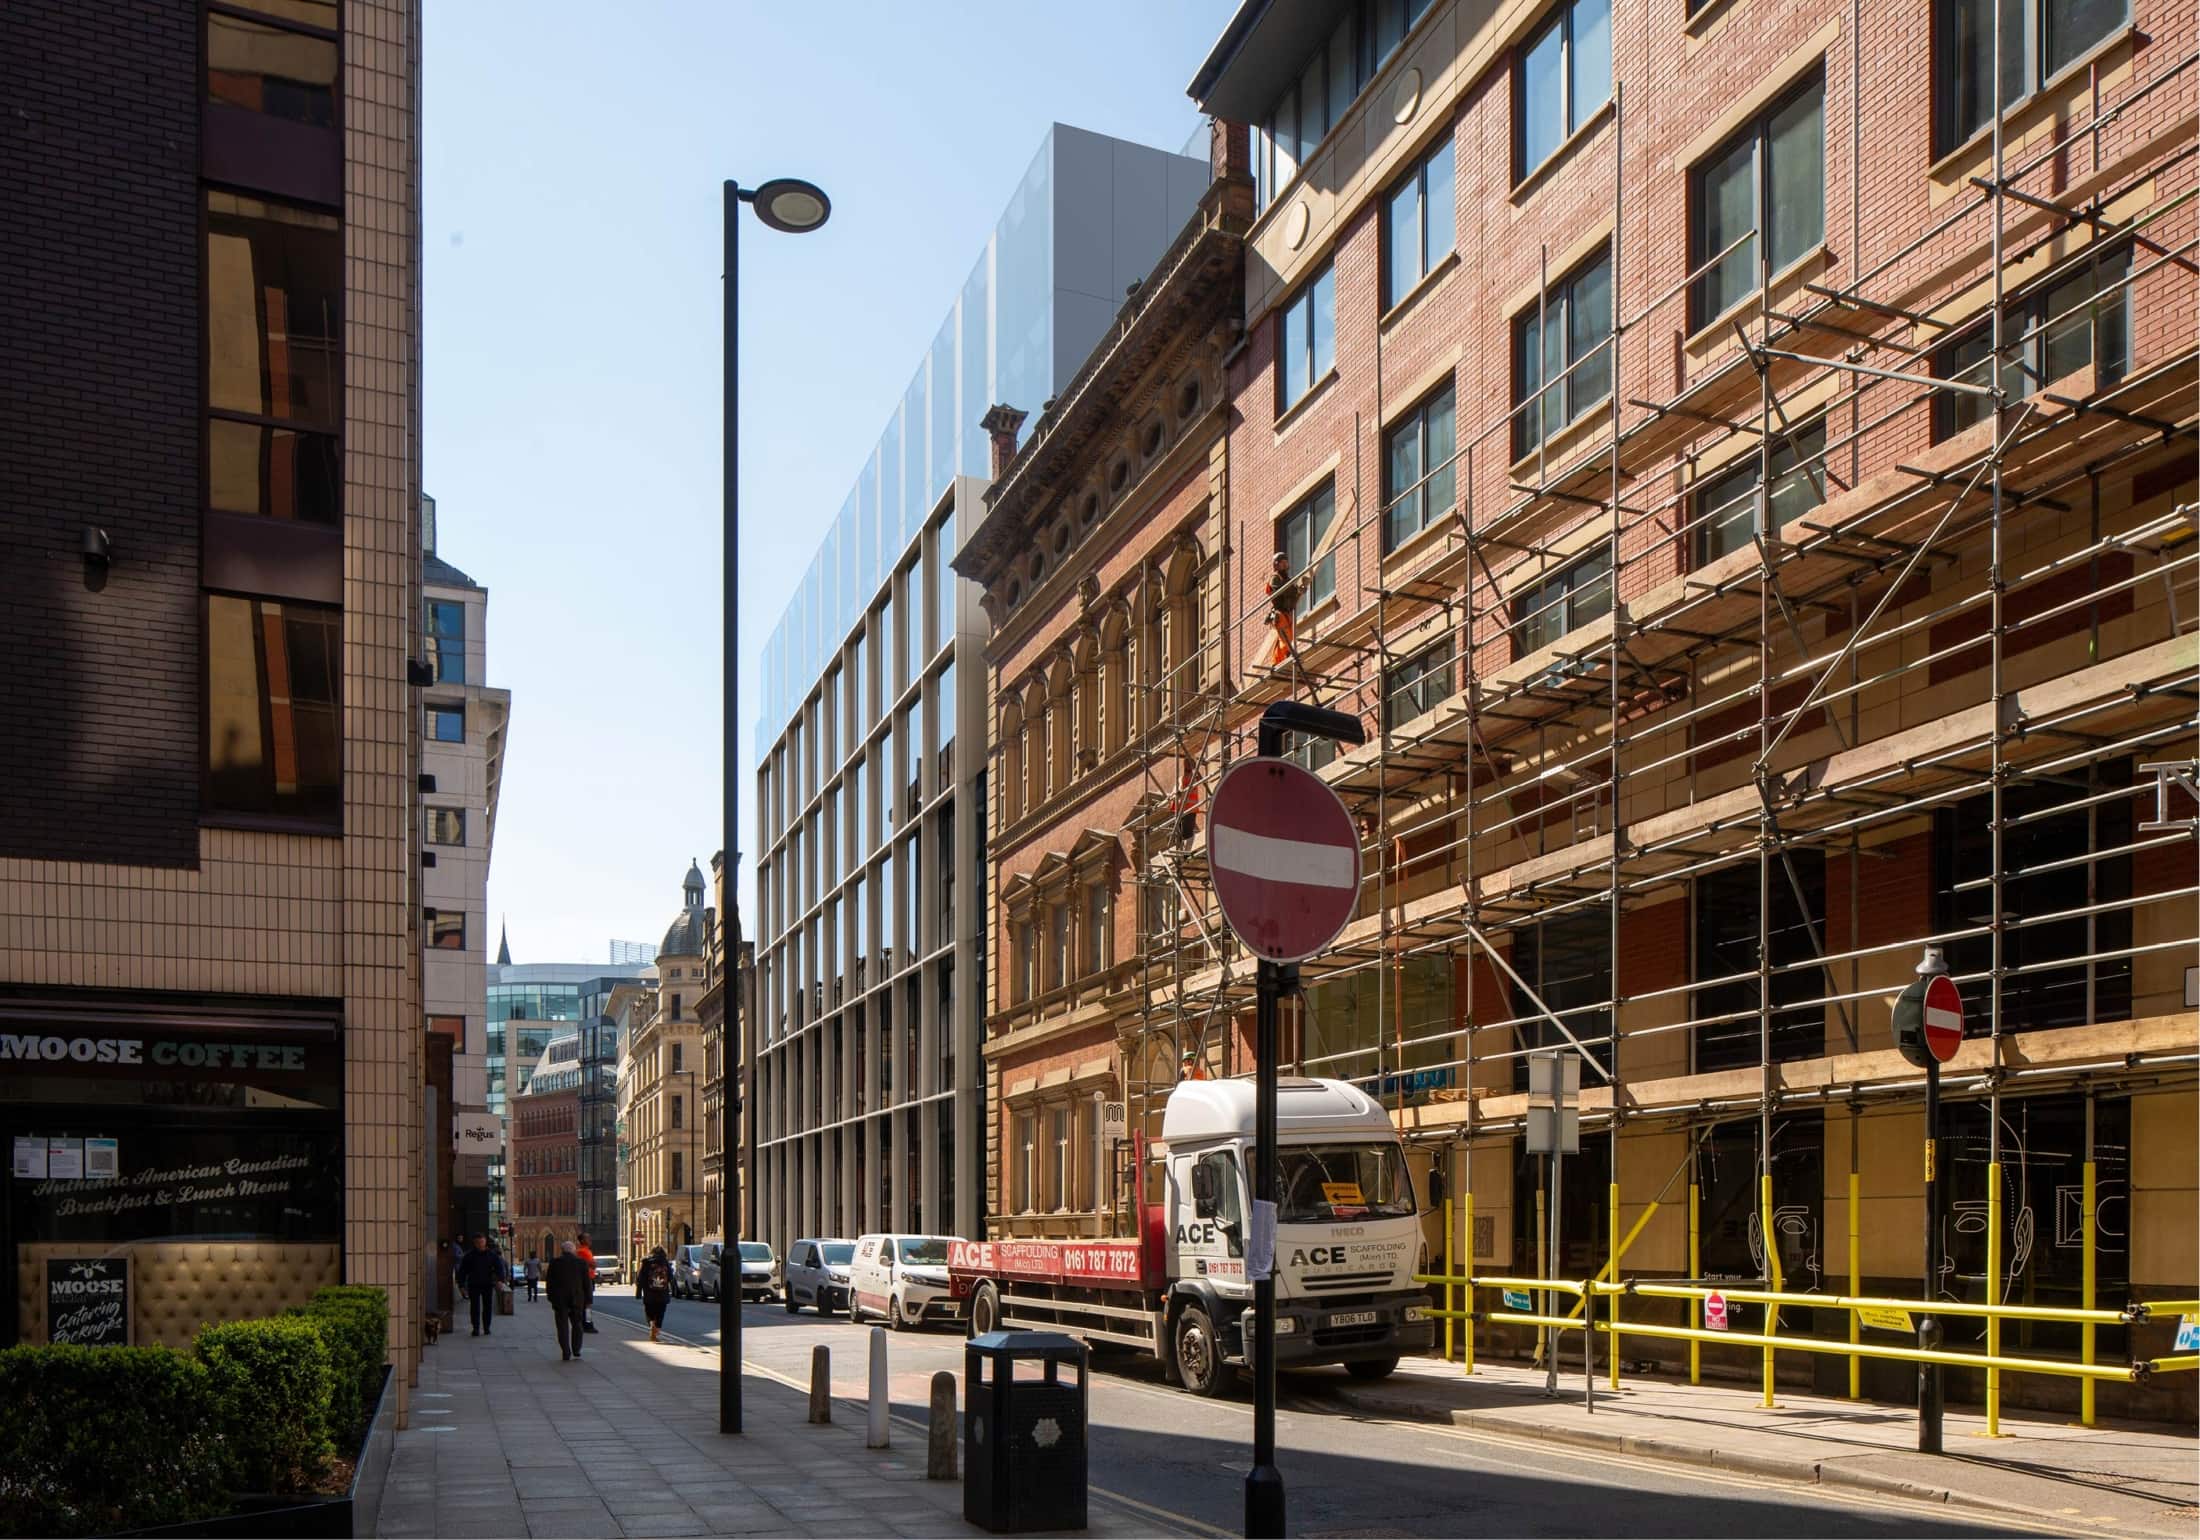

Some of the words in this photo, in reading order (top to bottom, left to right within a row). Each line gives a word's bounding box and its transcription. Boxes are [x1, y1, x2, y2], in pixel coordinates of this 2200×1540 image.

[0, 1034, 144, 1064] MOOSE
[152, 1041, 305, 1071] COFFEE
[465, 1127, 495, 1142] Regus
[133, 1166, 222, 1185] American
[224, 1156, 309, 1176] Canadian
[56, 1194, 151, 1216] Breakfast
[154, 1189, 173, 1205] &
[176, 1181, 236, 1203] Lunch
[237, 1179, 290, 1197] Menu
[1176, 1223, 1215, 1244] ACE
[1331, 1226, 1365, 1238] IVECO
[952, 1243, 994, 1268] ACE
[1000, 1244, 1059, 1259] SCAFFOLDING
[1064, 1249, 1085, 1270] 0161
[1088, 1250, 1106, 1272] 787
[1109, 1250, 1137, 1273] 7872
[1290, 1246, 1347, 1267] ACE
[1350, 1242, 1407, 1254] SCAFFOLDING
[51, 1279, 124, 1294] MOOSE
[1703, 1271, 1723, 1281] Start
[56, 1301, 121, 1330] Catering
[50, 1316, 123, 1344] Packages
